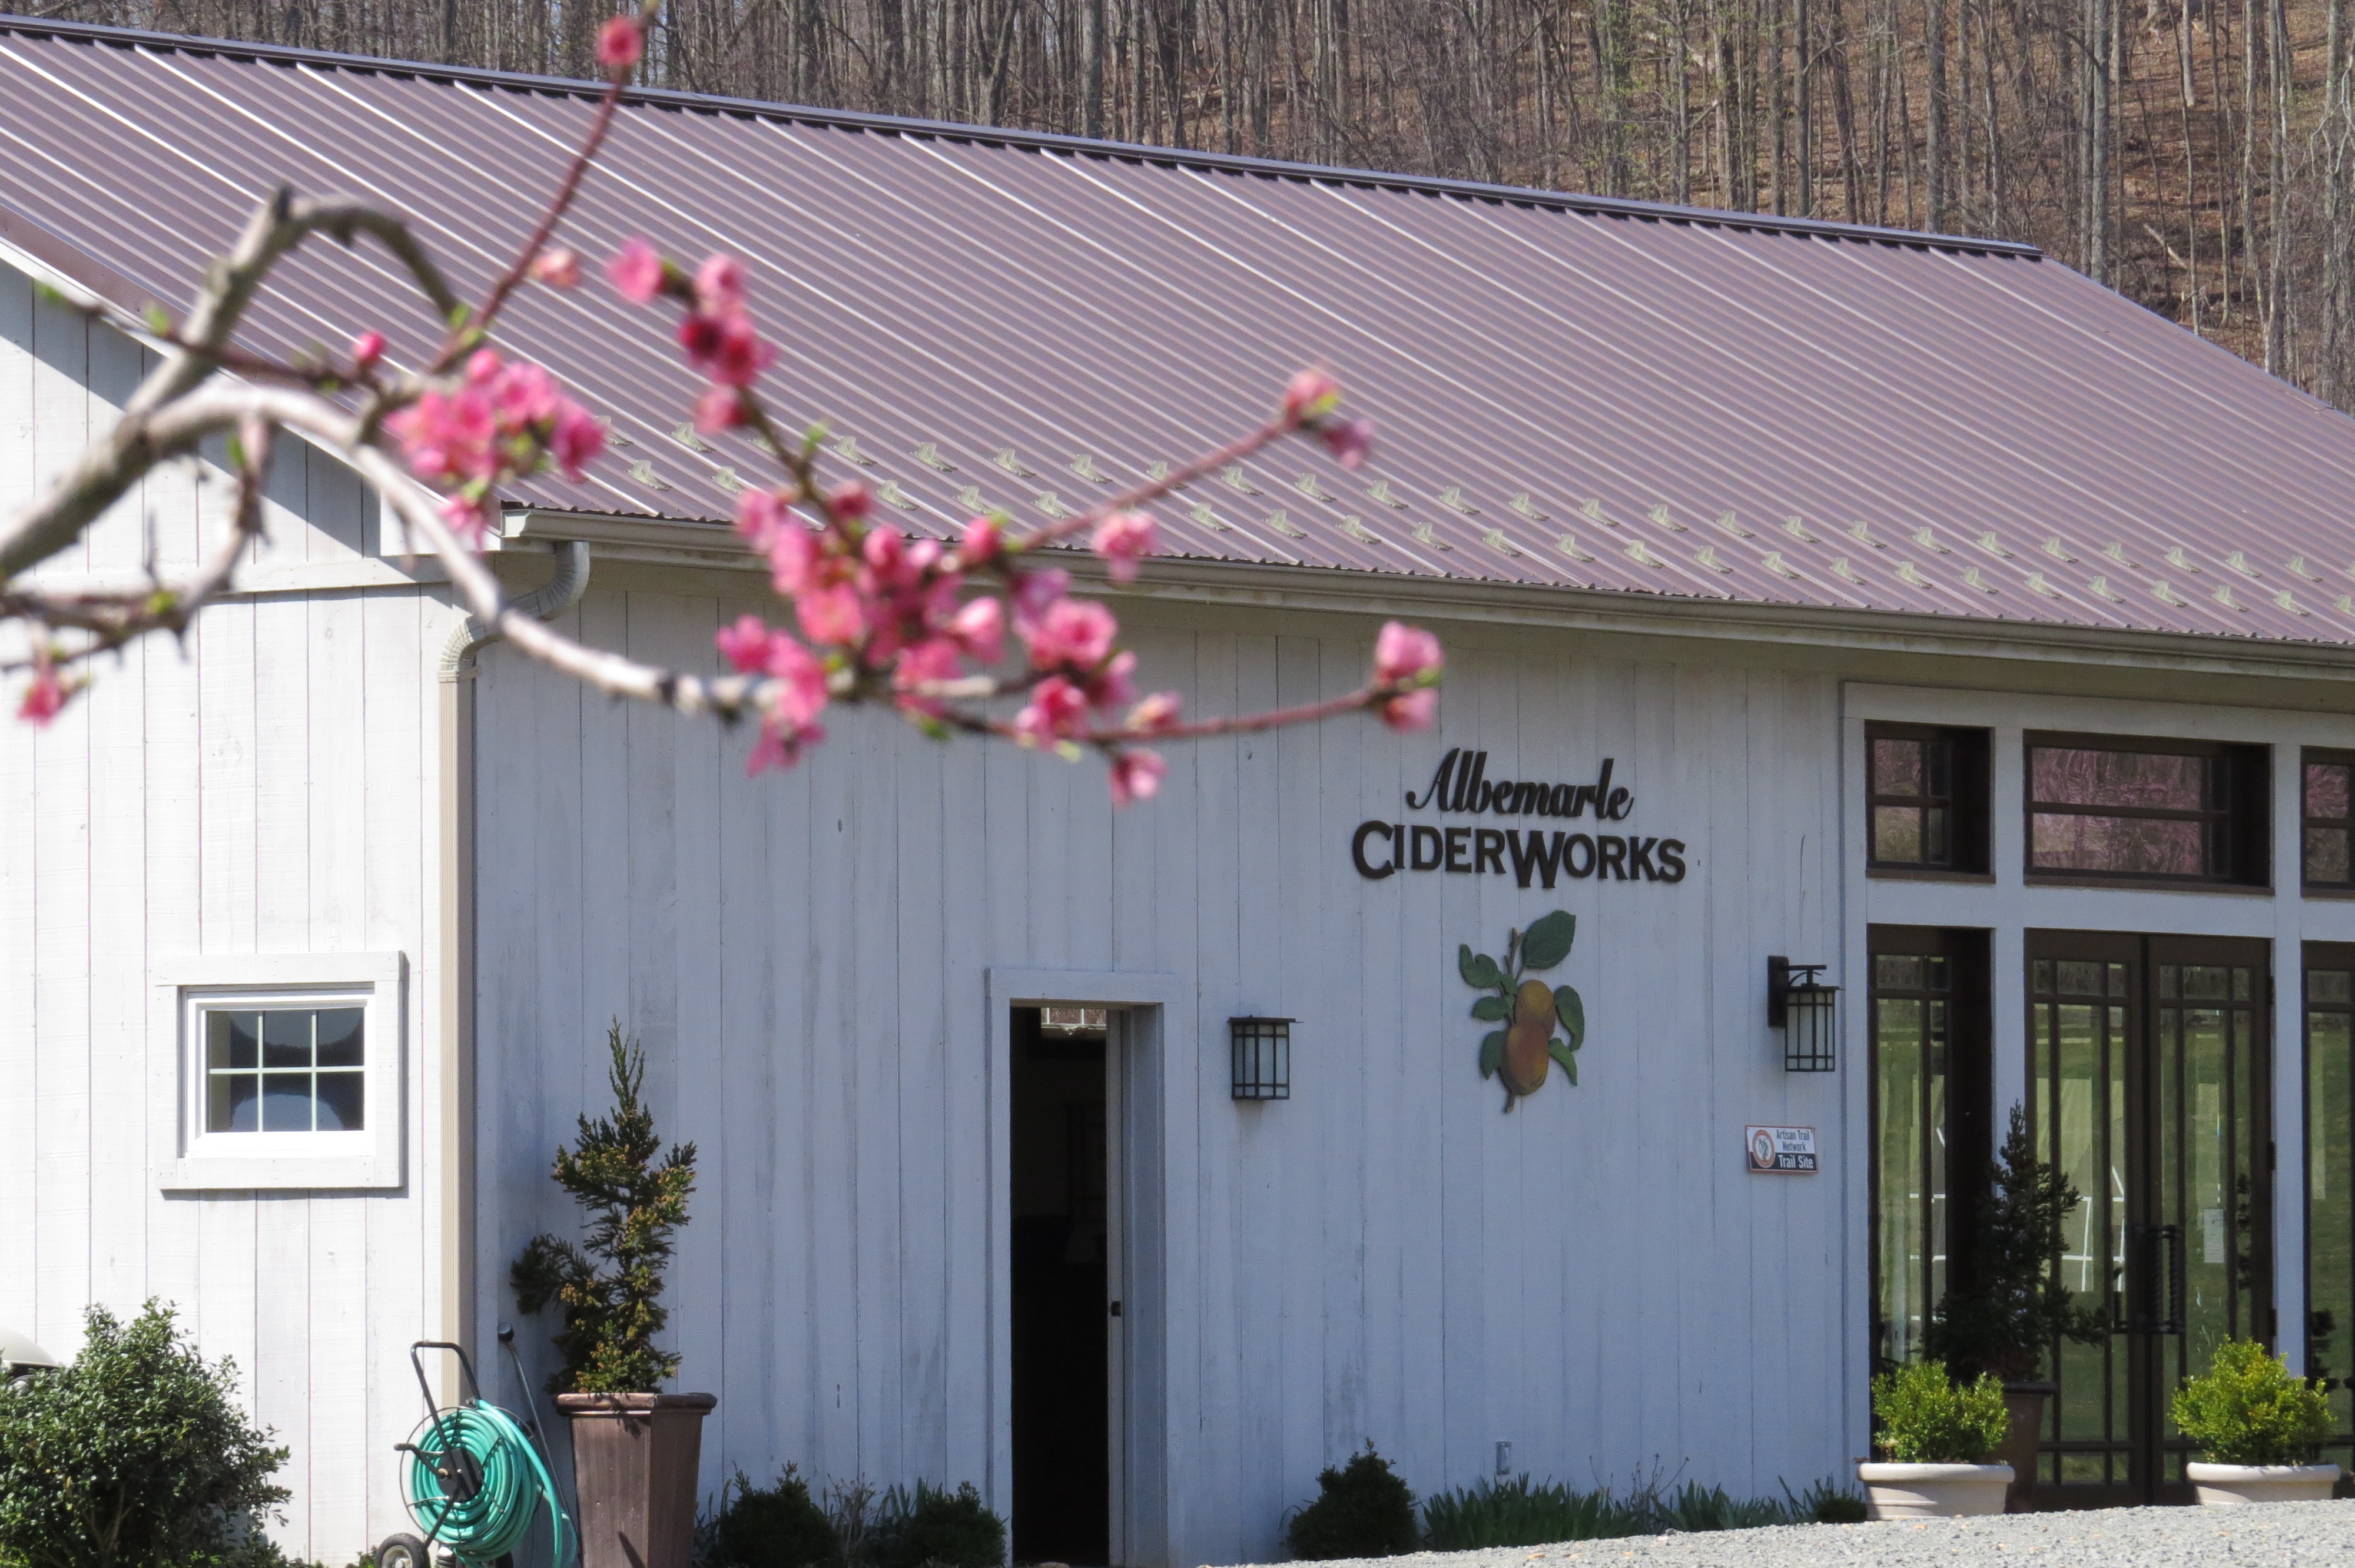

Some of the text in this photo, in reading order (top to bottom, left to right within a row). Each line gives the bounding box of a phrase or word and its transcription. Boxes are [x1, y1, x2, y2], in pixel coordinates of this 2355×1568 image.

[1406, 748, 1634, 820] Albemarle
[1353, 820, 1686, 889] CIDERWORKS
[1776, 1130, 1810, 1141] Artisan Trail
[1783, 1141, 1806, 1152] Network
[1778, 1155, 1813, 1168] Trail Site
